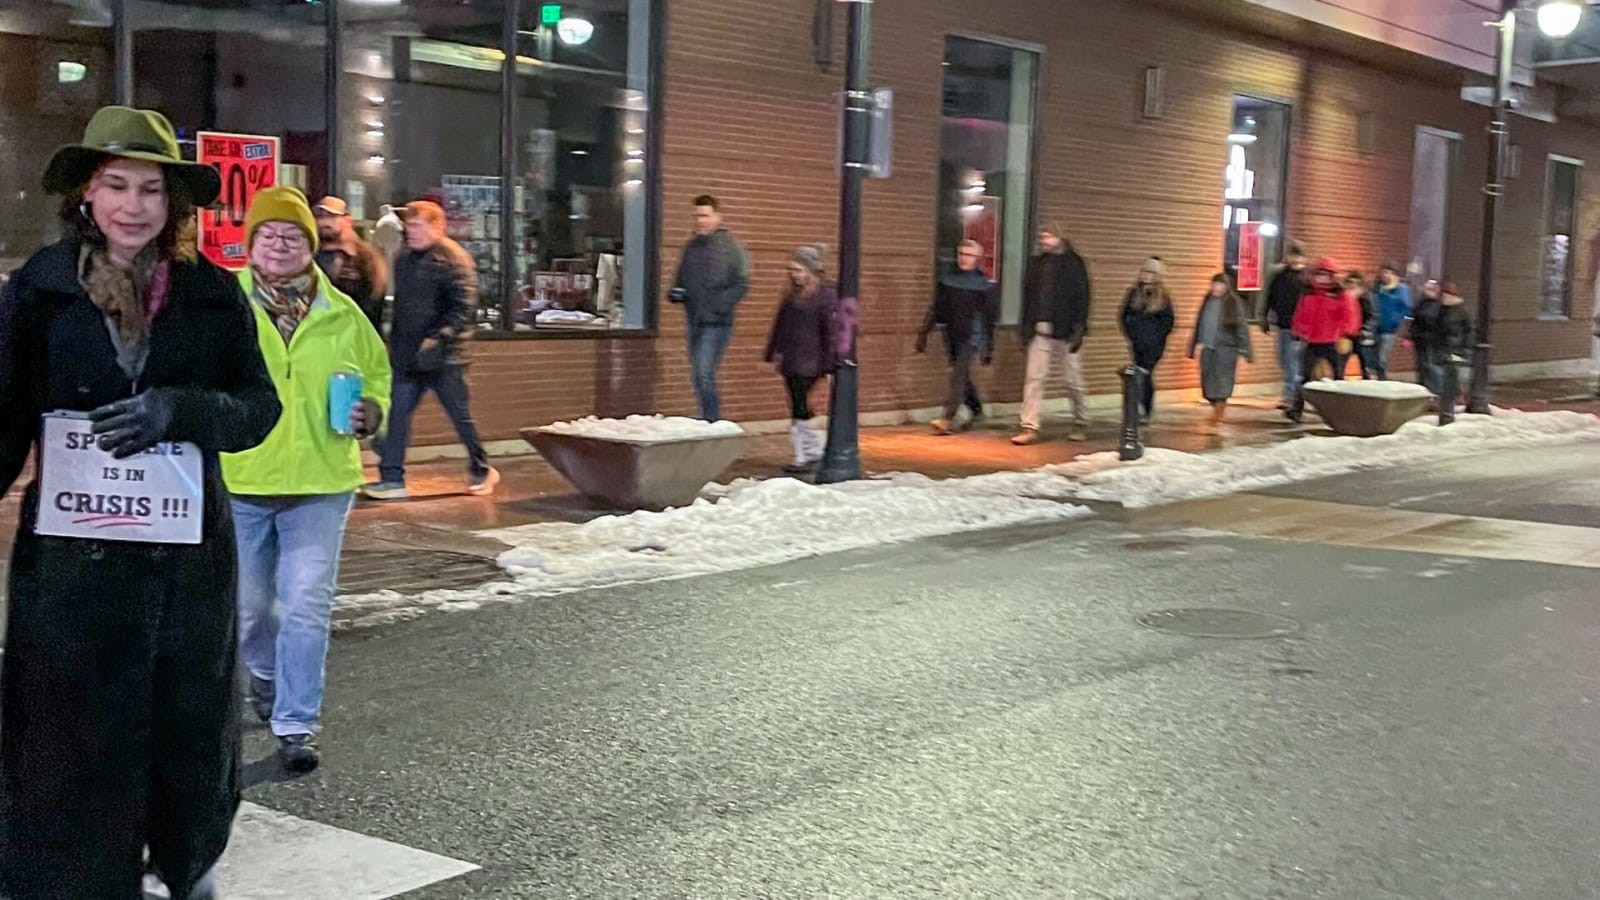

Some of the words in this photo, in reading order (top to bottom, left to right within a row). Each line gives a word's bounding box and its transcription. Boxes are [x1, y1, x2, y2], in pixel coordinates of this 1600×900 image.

[102, 467, 119, 480] IS
[125, 468, 145, 481] IN
[55, 491, 151, 517] CRISIS
[161, 498, 189, 518] !!!
